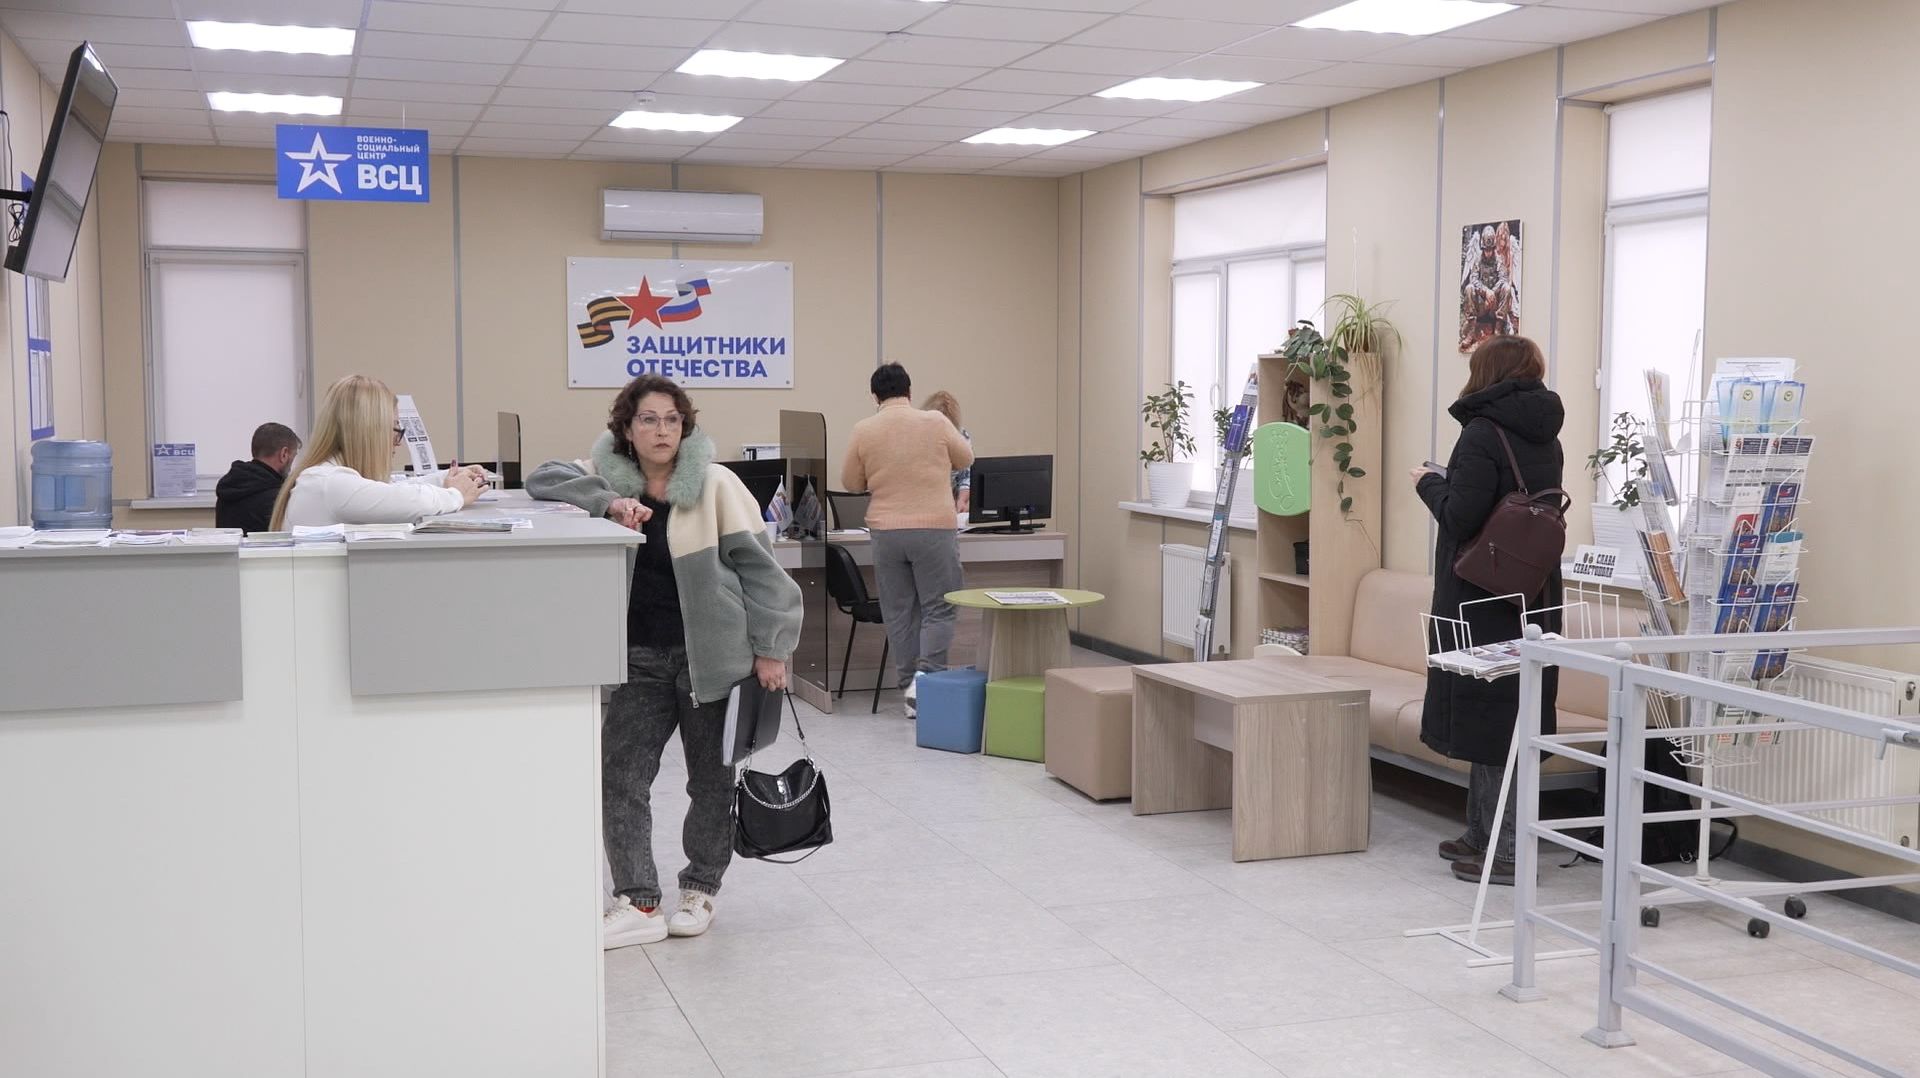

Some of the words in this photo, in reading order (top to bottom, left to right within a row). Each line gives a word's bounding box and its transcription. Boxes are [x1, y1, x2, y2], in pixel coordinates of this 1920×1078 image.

[356, 135, 397, 144] ВОЕННО-
[356, 144, 420, 153] СОЦИАЛЬНЫЙ
[357, 152, 387, 160] ЦЕНТР
[357, 163, 423, 196] ВСЦ
[626, 335, 786, 357] ЗАЩИТНИКИ
[626, 358, 768, 378] ОТЕЧЕСТВА
[1596, 553, 1617, 567] СЛАВА
